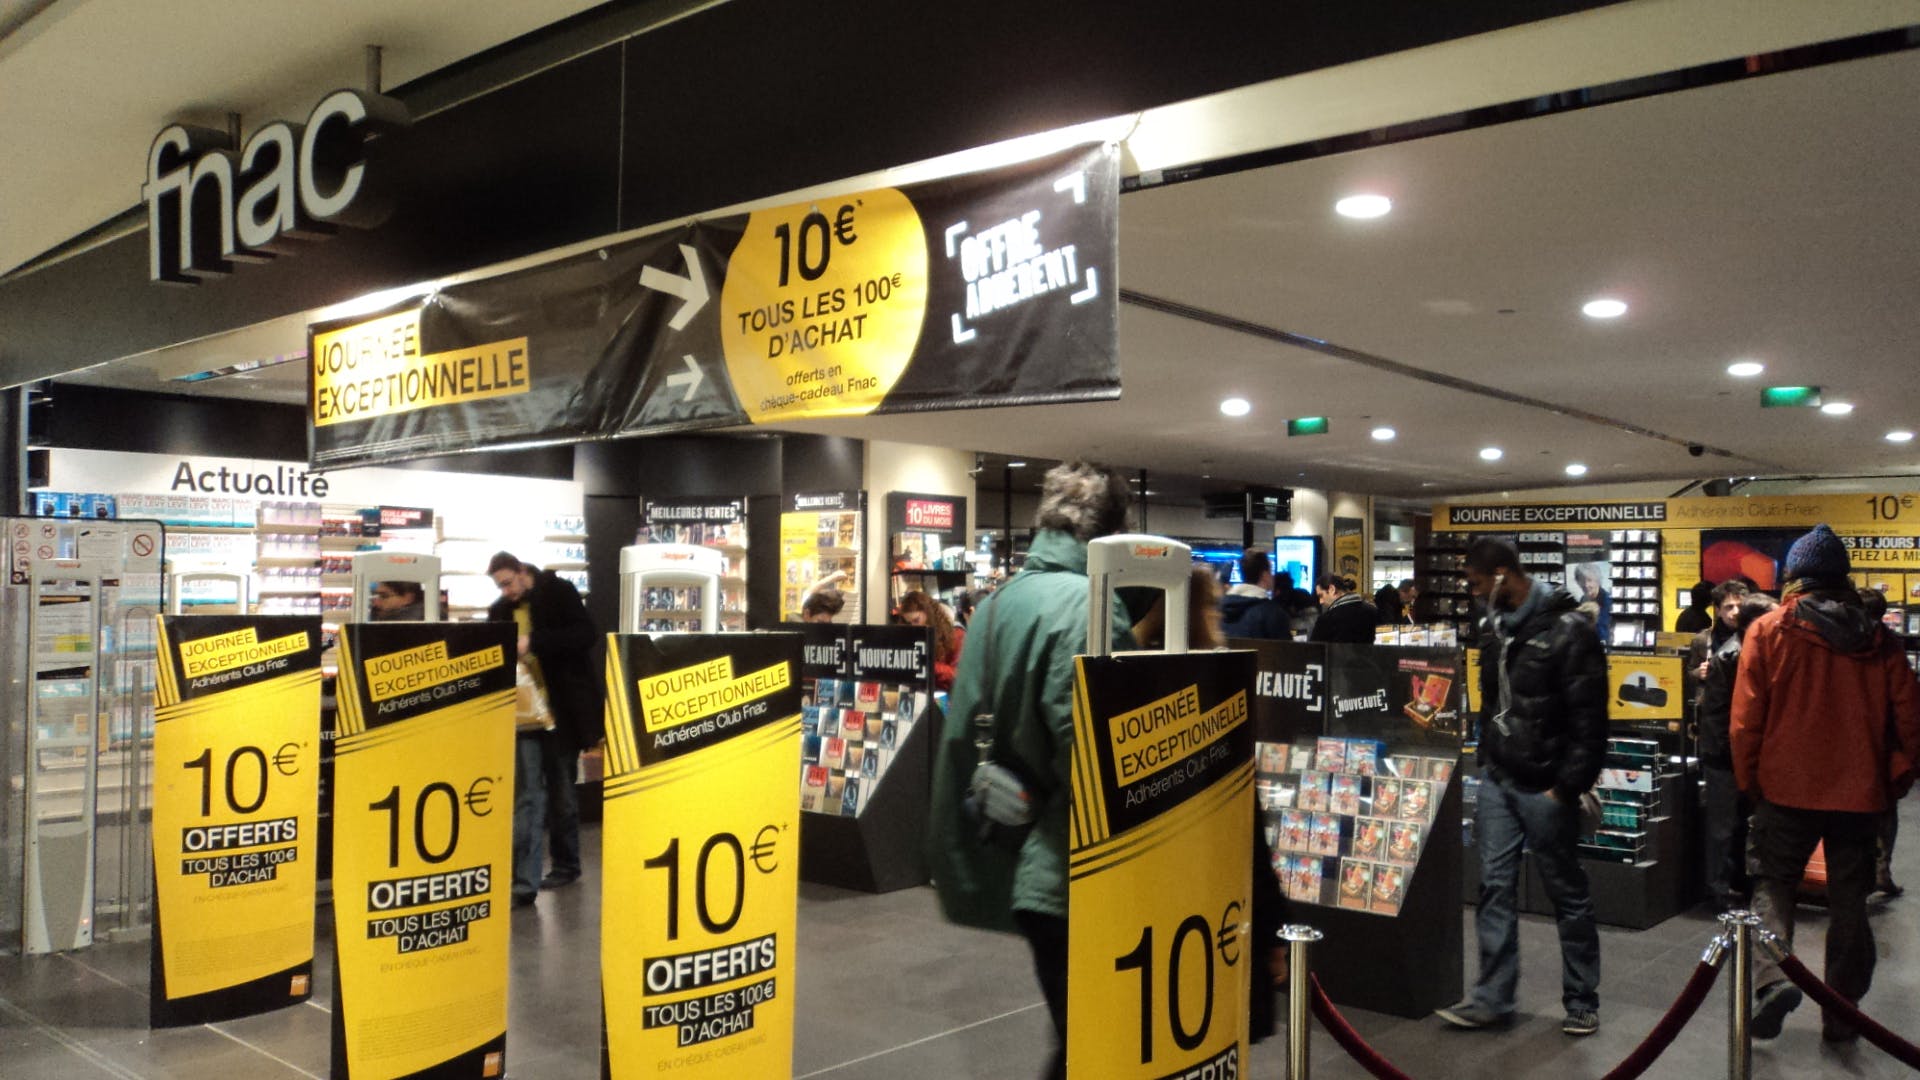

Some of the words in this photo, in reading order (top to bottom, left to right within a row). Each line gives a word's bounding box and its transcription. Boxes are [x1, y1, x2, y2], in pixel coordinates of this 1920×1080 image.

[142, 89, 367, 281] fnac
[737, 301, 795, 336] TOUS
[801, 290, 846, 325] LES
[853, 272, 902, 311] 100€
[317, 323, 416, 377] JOURÉE
[768, 313, 868, 359] D'ACHAT
[318, 348, 526, 420] EXCEPTIONNELLE
[786, 367, 825, 387] offerts
[828, 364, 842, 378] en
[847, 376, 878, 392] Fnac
[171, 461, 330, 498] Actualité
[650, 506, 702, 519] MEILLEURES
[704, 506, 737, 519] VENTES
[907, 507, 923, 524] 10
[923, 504, 951, 515] LIVRES
[1524, 505, 1664, 521] EXCEPTIONNELLE
[1849, 550, 1880, 561] FLEZ
[1884, 550, 1900, 561] LA
[1904, 550, 1920, 561] MI
[1859, 537, 1873, 548] 15
[1875, 537, 1915, 548] JOURS
[185, 629, 254, 657] JOURNÉE
[188, 636, 306, 675] EXCEPTIONNELLE
[371, 644, 444, 676] JOURNÉE
[859, 644, 920, 670] NOUVEAUTÉ
[192, 669, 242, 689] Adhérents
[242, 663, 266, 679] Club
[266, 658, 288, 673] Fnac
[375, 650, 500, 697] EXCEPTIONNELLE
[646, 661, 728, 700] JOURNÉE
[378, 692, 432, 715] Adhérents
[432, 685, 457, 700] Club
[458, 677, 481, 692] Fnac
[650, 667, 787, 726] EXCEPTIONNELLE
[1338, 692, 1382, 713] NOUVEAUTÉ
[654, 721, 715, 749] Adhérents
[716, 710, 742, 729] Club
[742, 701, 767, 720] Fnac
[1116, 691, 1198, 745] JOURNÉE
[1121, 696, 1246, 779] EXCEPTIONNELLE
[1125, 769, 1184, 808] Adhérents
[185, 819, 296, 850] OFFERTS
[185, 857, 229, 873] TOUS
[232, 854, 260, 869] LES
[263, 849, 296, 865] 100€
[212, 866, 274, 887] D'ACHAT
[371, 868, 489, 909] OFFERTS
[371, 916, 419, 937] TOUS
[422, 910, 450, 930] LES
[454, 903, 489, 924] 100€
[400, 925, 466, 952] D'ACHAT
[646, 937, 774, 992] OFFERTS
[646, 1000, 700, 1026] TOUS
[704, 992, 735, 1016] LES
[739, 980, 774, 1005] 100€
[680, 1009, 752, 1045] D'ACHAT
